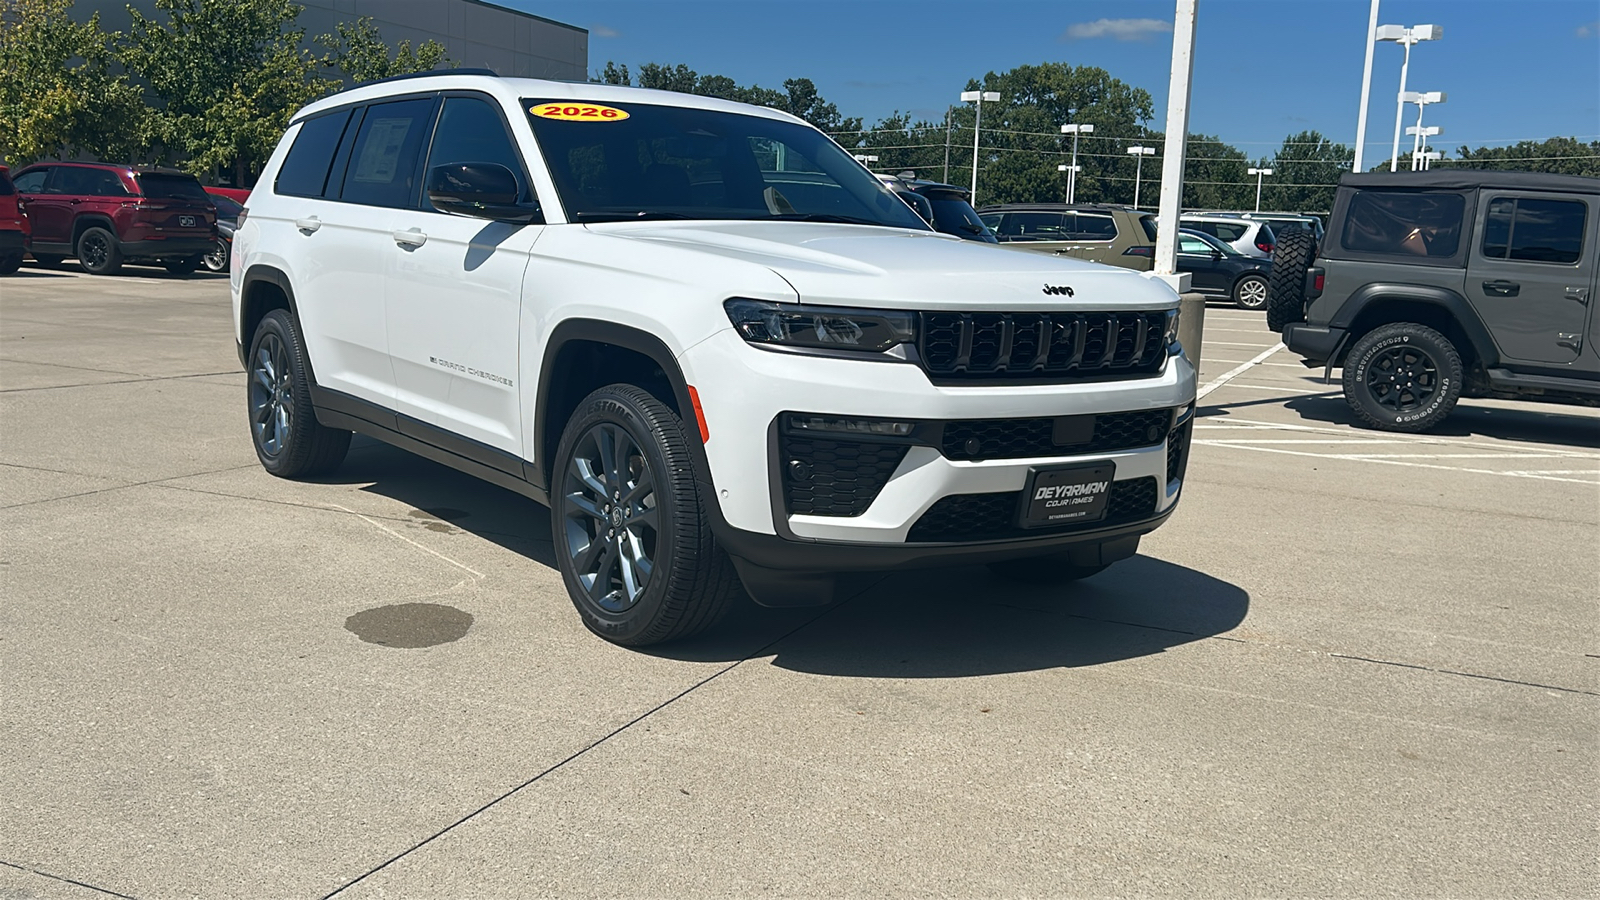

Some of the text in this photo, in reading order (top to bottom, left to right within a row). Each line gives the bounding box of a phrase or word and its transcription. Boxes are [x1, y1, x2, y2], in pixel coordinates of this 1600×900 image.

[543, 106, 618, 118] 2026
[1042, 283, 1074, 298] Jeep
[438, 358, 514, 387] GRAND CHEROKEE
[1034, 481, 1108, 500] DEYARMAN
[1071, 496, 1094, 505] AMES
